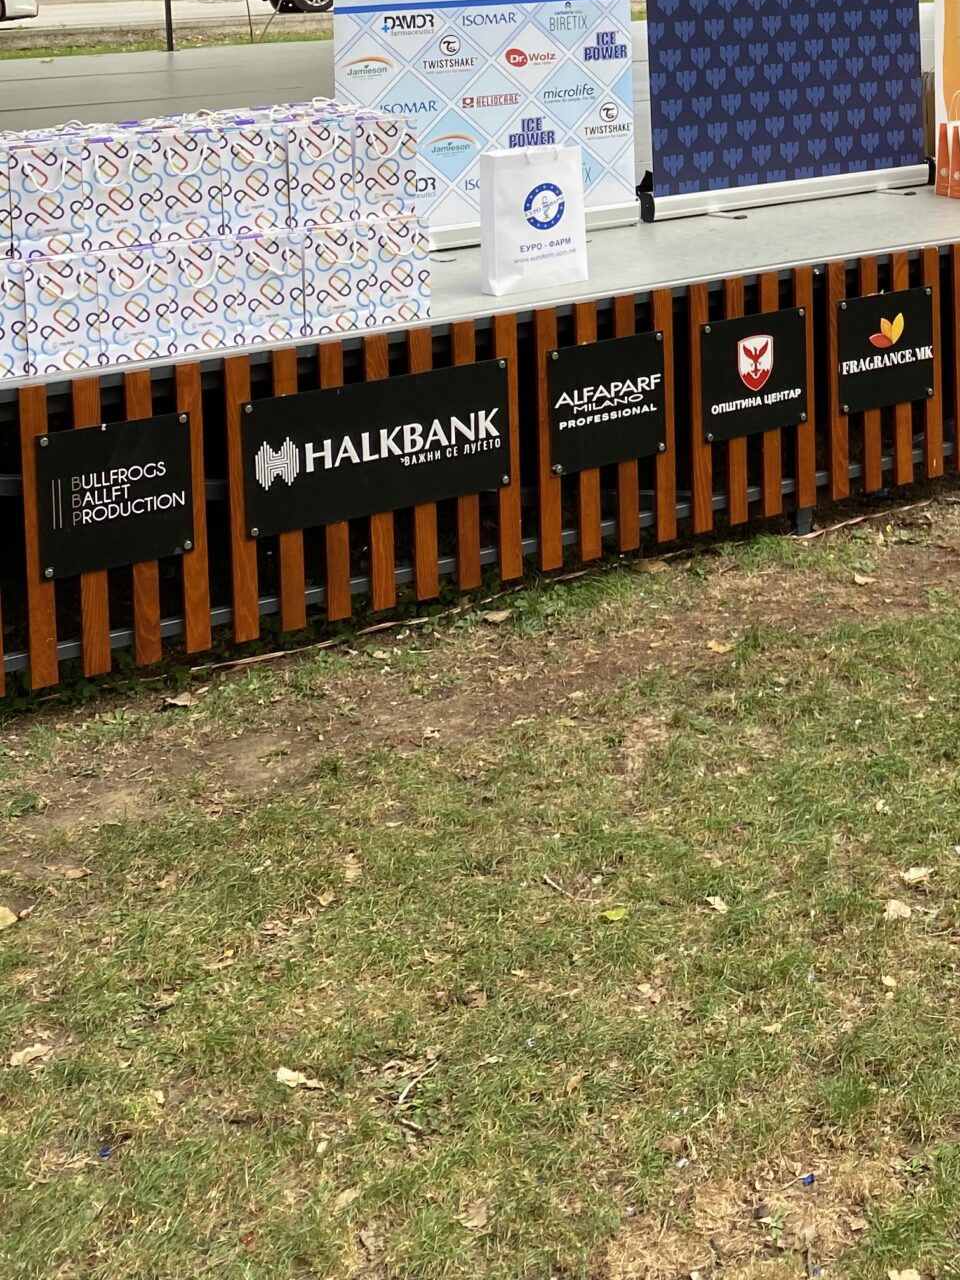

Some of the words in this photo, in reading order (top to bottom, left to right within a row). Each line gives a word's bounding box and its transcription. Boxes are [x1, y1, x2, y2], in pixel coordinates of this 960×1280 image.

[462, 11, 518, 27] ISOMAR
[549, 15, 588, 32] BIRETIX
[596, 31, 617, 46] ICE
[509, 54, 527, 64] Dr.
[528, 52, 556, 62] Wolz
[583, 44, 628, 62] POWER
[347, 65, 388, 76] Jamieson
[423, 57, 475, 70] TWISTSHAKE
[543, 83, 594, 99] microlife
[476, 93, 519, 108] HELIOCARE
[521, 117, 543, 132] ICE
[584, 123, 631, 136] TWISTSHAKE
[431, 142, 471, 153] Jamieson
[509, 131, 555, 149] POWER
[841, 345, 934, 376] FRAGRANCE.MK
[554, 373, 662, 409] ALFAPARF
[573, 393, 644, 414] MILANO
[711, 396, 762, 415] ОПШТИНА
[763, 388, 802, 405] ЦЕНТАР
[559, 403, 658, 431] PROFESSIONAL
[304, 407, 501, 474] HALKBANK
[446, 446, 459, 458] СЕ
[71, 461, 167, 491] BULLFROGS
[72, 490, 186, 526] PRODUCTION
